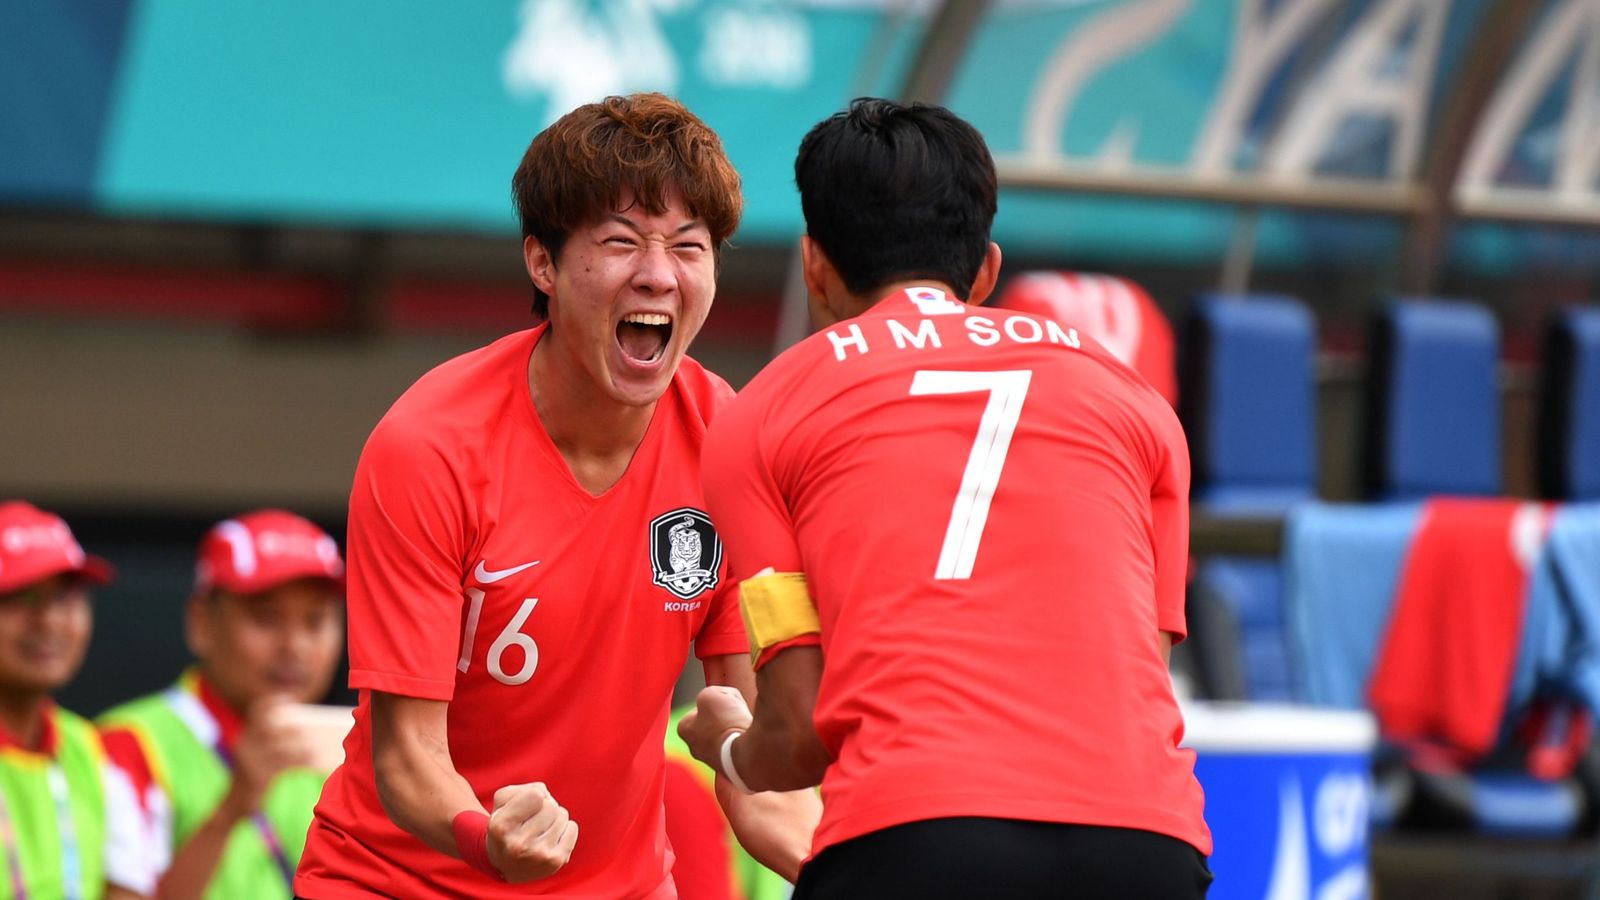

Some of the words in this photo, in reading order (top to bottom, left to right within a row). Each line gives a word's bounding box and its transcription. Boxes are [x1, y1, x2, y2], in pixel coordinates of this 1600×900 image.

[826, 323, 869, 362] H
[886, 319, 942, 349] M
[964, 315, 1081, 349] SON
[909, 369, 1033, 580] 7
[456, 587, 539, 686] 16
[664, 601, 701, 612] KOREA
